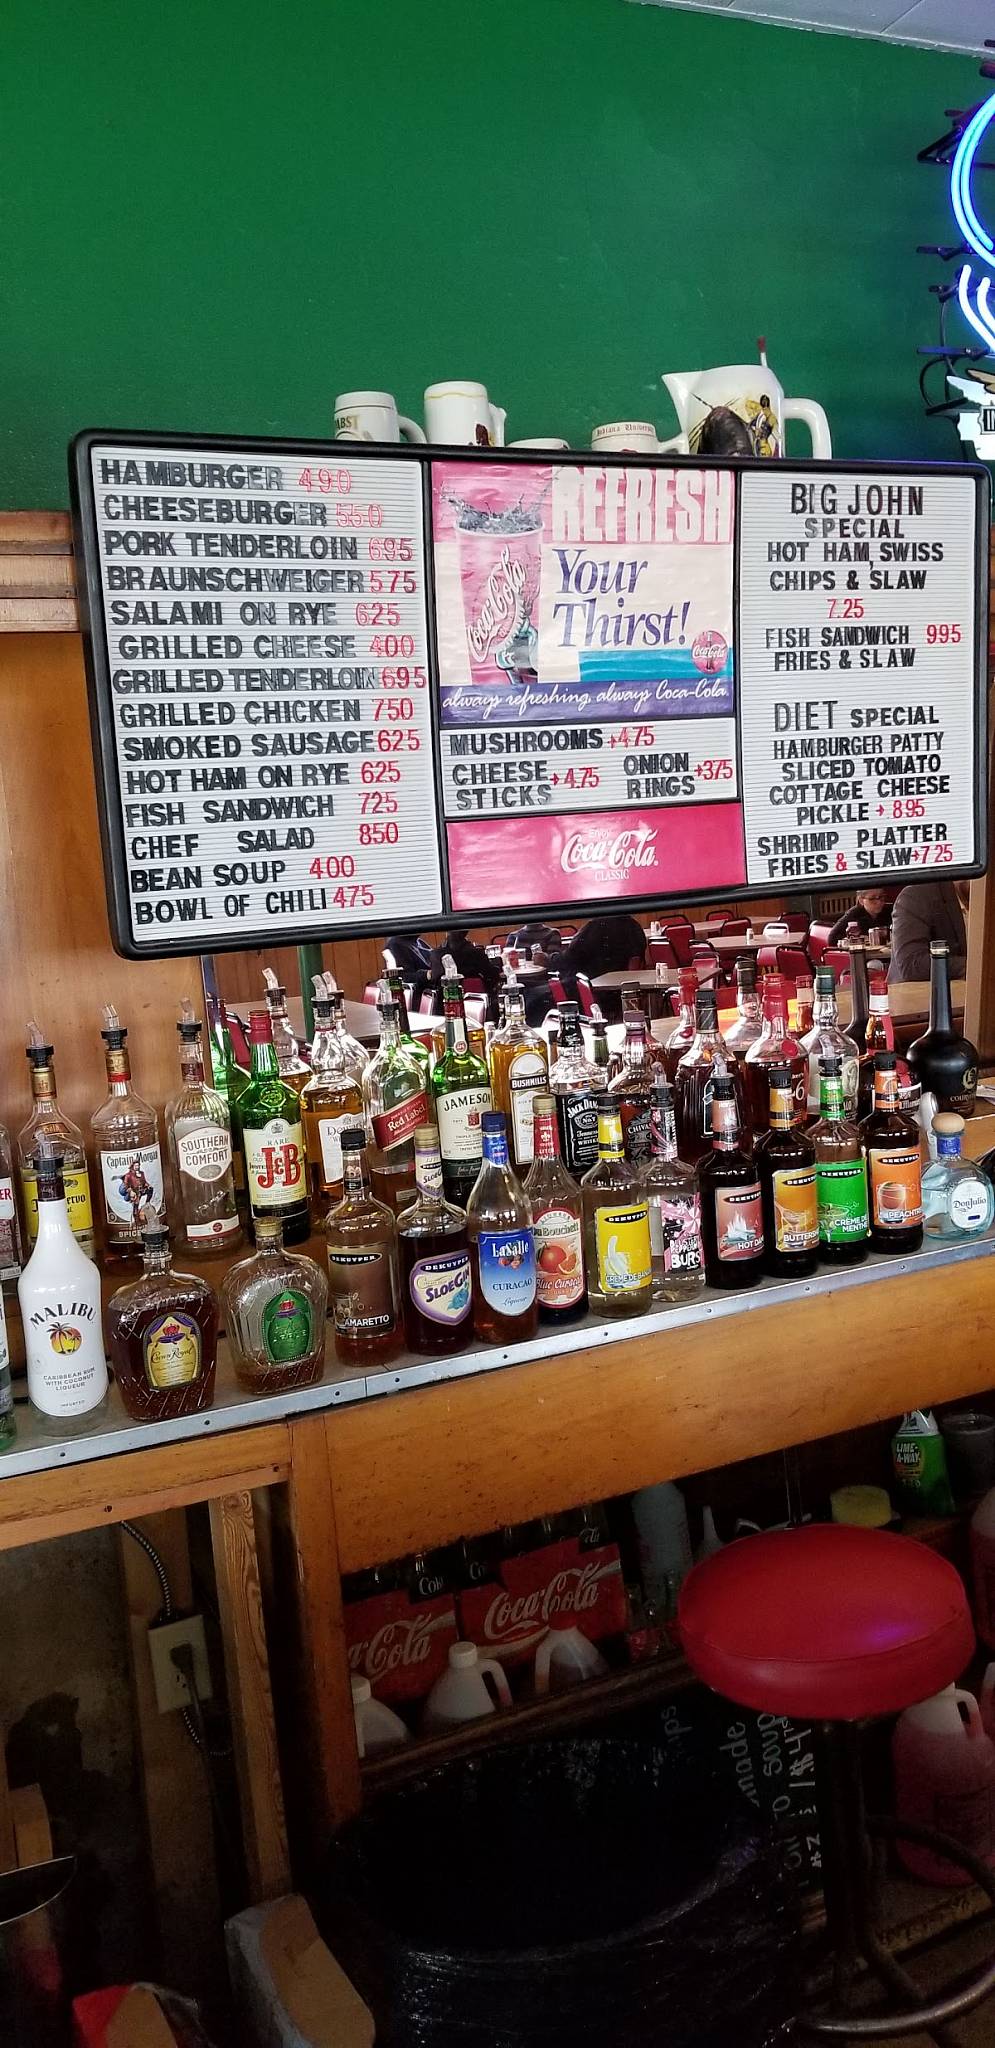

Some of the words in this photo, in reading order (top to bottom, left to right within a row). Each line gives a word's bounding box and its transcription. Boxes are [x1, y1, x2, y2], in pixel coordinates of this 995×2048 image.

[100, 459, 284, 491] HAMBURGER
[298, 467, 351, 494] 490
[103, 494, 328, 527] CHEESEBURGER
[336, 502, 384, 528] 550
[552, 467, 733, 543] REFRESH
[791, 483, 837, 515] BIG
[848, 484, 924, 516] JOHN
[804, 518, 905, 538] SPECIAL
[104, 530, 177, 556] PORK
[186, 531, 359, 560] TENDERLOIN
[368, 537, 414, 561] 695
[767, 541, 809, 562] HOT
[879, 542, 944, 562] SWISS
[106, 564, 365, 593] BRAUNSCHWEIGER
[369, 570, 417, 594] 575
[552, 548, 648, 594] Your
[769, 570, 836, 591] CHIPS
[846, 569, 859, 590] &
[869, 569, 928, 590] SLAW
[110, 600, 224, 626] SALAMI
[239, 602, 277, 625] ON
[288, 602, 338, 625] RYE
[355, 602, 401, 626] 625
[552, 596, 692, 648] Thirst!
[118, 634, 243, 660] GRILLED
[253, 634, 356, 660] CHEESE
[368, 634, 415, 658] 400
[765, 627, 811, 649] FISH
[820, 625, 911, 647] SANDWICH
[926, 623, 962, 645] 995
[773, 650, 831, 672] FRIES
[838, 649, 852, 669] &
[859, 648, 917, 669] SLAW
[112, 668, 223, 695] GRILLED
[228, 667, 379, 693] TENDERLOIN
[381, 665, 427, 690] 695
[119, 701, 236, 728] GRILLED
[243, 698, 360, 727] CHICKEN
[371, 697, 414, 721] 750
[442, 686, 502, 720] always
[504, 682, 592, 717] refreshing,
[596, 681, 652, 714] always
[774, 700, 838, 733] DIET
[850, 705, 939, 729] SPECIAL
[122, 733, 241, 762] SMOKED
[251, 729, 376, 757] SAUSAGE
[377, 728, 421, 752] 625
[449, 727, 604, 758] MUSHROOMS
[773, 734, 883, 760] HAMBURGER
[890, 731, 945, 753] PATTY
[125, 768, 182, 795] HOT
[190, 765, 247, 792] HAM
[257, 763, 293, 788] ON
[301, 761, 350, 786] RYE
[360, 760, 401, 784] 625
[452, 759, 549, 787] CHEESE
[623, 752, 690, 777] ONION
[781, 758, 855, 783] SLICED
[863, 754, 942, 777] TOMATO
[455, 783, 552, 812] STICKS
[627, 774, 696, 800] RINGS
[769, 780, 863, 806] COTTAGE
[877, 774, 950, 799] CHEESE
[125, 800, 186, 828] FISH
[202, 794, 335, 824] SANDWICH
[358, 790, 399, 816] 725
[796, 802, 870, 827] PICKLE
[131, 833, 199, 861] CHEF
[237, 826, 315, 854] SALAD
[358, 821, 399, 846] 850
[757, 831, 840, 858] SHRIMP
[857, 822, 948, 848] PLATTER
[130, 865, 202, 894] BEAN
[213, 859, 287, 888] SOUP
[309, 855, 355, 880] 400
[595, 868, 630, 881] CLASSIC
[767, 853, 829, 879] FRIES
[835, 852, 848, 872] &
[856, 847, 912, 871] SLAW
[135, 895, 214, 926] BOWL
[224, 893, 250, 917] OF
[265, 888, 328, 915] CHILI
[332, 884, 375, 910] 475
[443, 1093, 491, 1112] JAMESO
[387, 1116, 405, 1132] Red
[404, 1103, 426, 1122] Label
[181, 1134, 228, 1152] SOUTHERN
[106, 1155, 133, 1169] Captain
[185, 1149, 228, 1167] COMFORT
[492, 1239, 529, 1258] LaSalle
[671, 1250, 701, 1269] BURS
[738, 1241, 753, 1250] HOT
[492, 1278, 533, 1292] CURACAO
[30, 1302, 97, 1330] MALIBU
[344, 1314, 390, 1328] AMARETTO
[43, 1371, 82, 1381] CARIBBEAN
[83, 1366, 96, 1375] RUM
[55, 1381, 86, 1391] LIQUEUR
[64, 1373, 94, 1385] COCONUT
